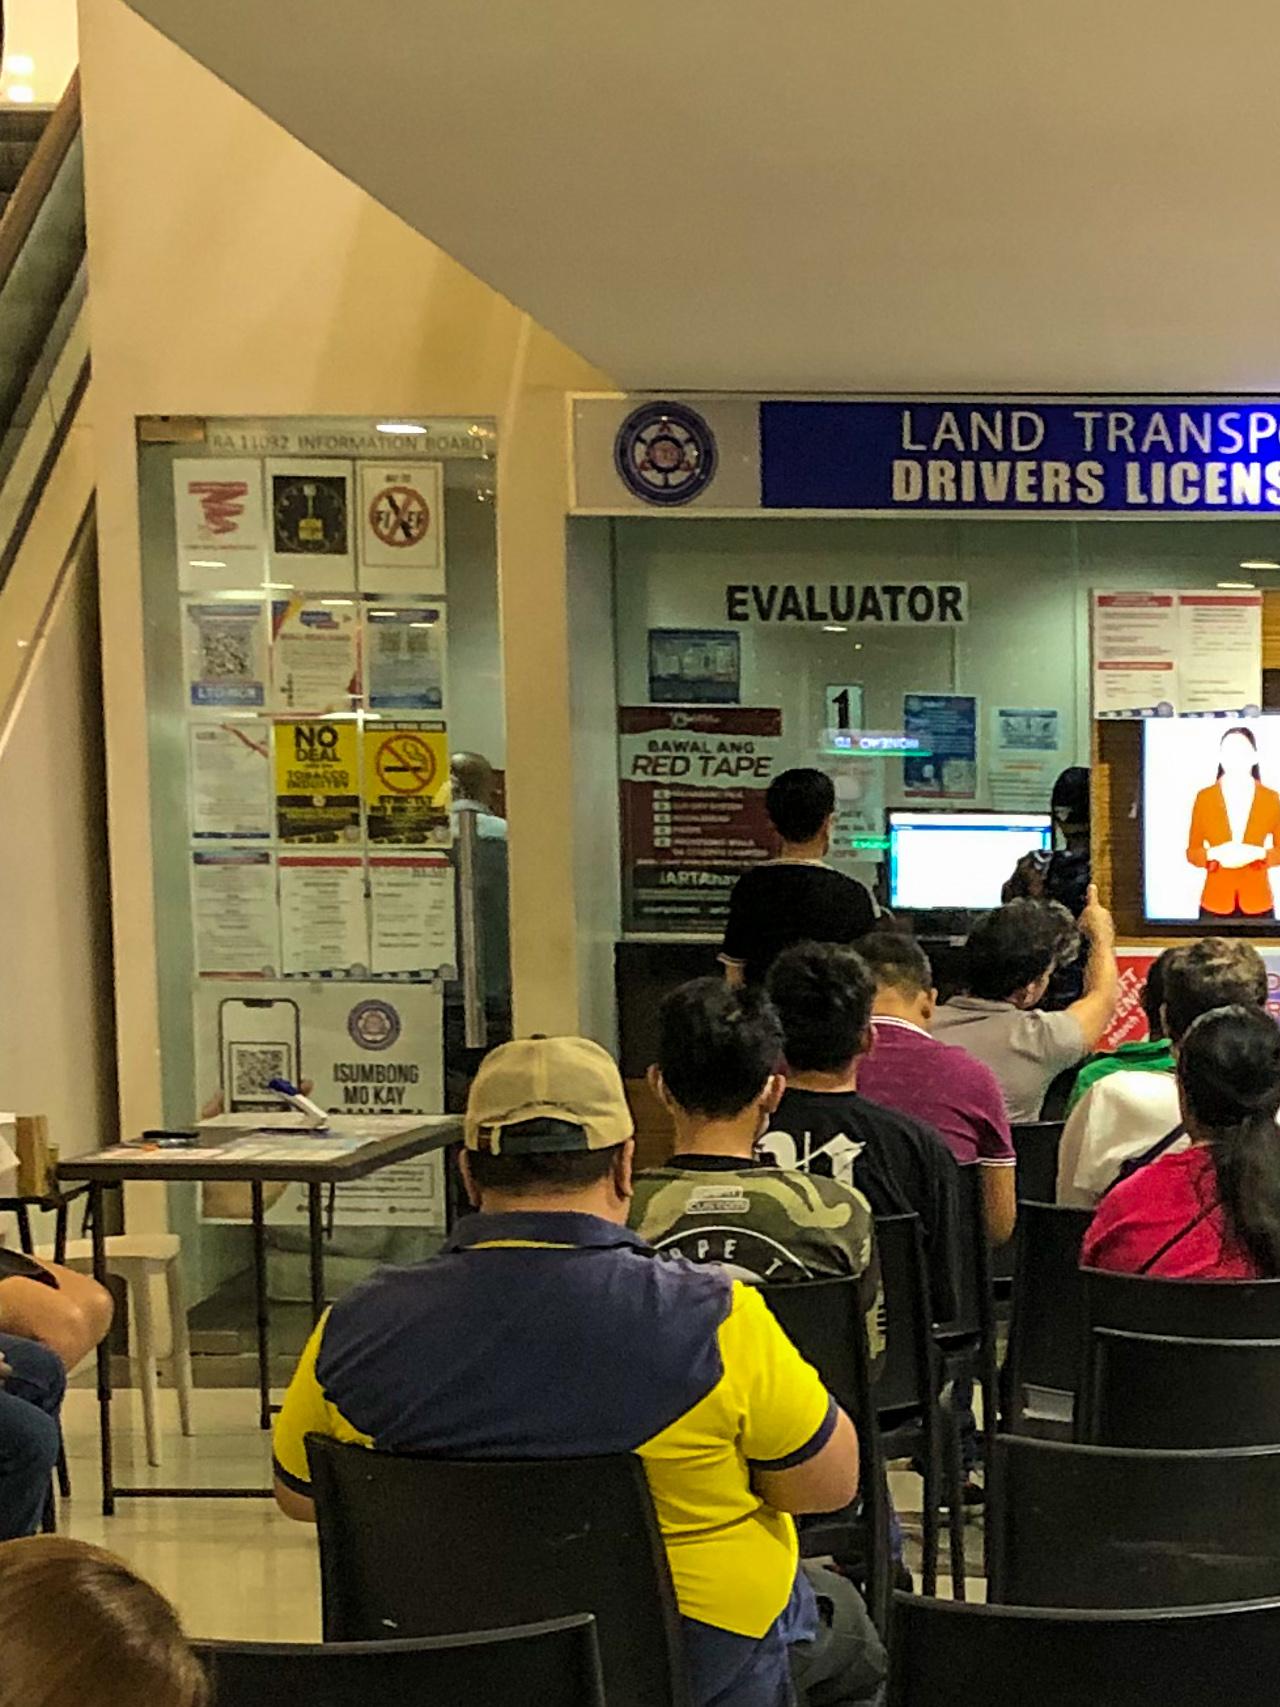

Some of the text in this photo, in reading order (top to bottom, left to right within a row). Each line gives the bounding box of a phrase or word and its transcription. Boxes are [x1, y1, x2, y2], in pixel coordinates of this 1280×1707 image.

[298, 434, 417, 450] INFORMATION
[425, 435, 484, 450] BOARD
[900, 411, 1045, 453] LAND
[892, 459, 1105, 504] DRIVERS
[726, 584, 963, 623] EVALUATOR
[832, 688, 850, 729] 1
[295, 725, 339, 748] NO
[648, 740, 756, 754] BAWAL ANG
[296, 748, 342, 762] DEAL
[631, 755, 774, 777] RED TAPE
[333, 1063, 419, 1083] ISUMBONG
[343, 1086, 406, 1105] MO KAY
